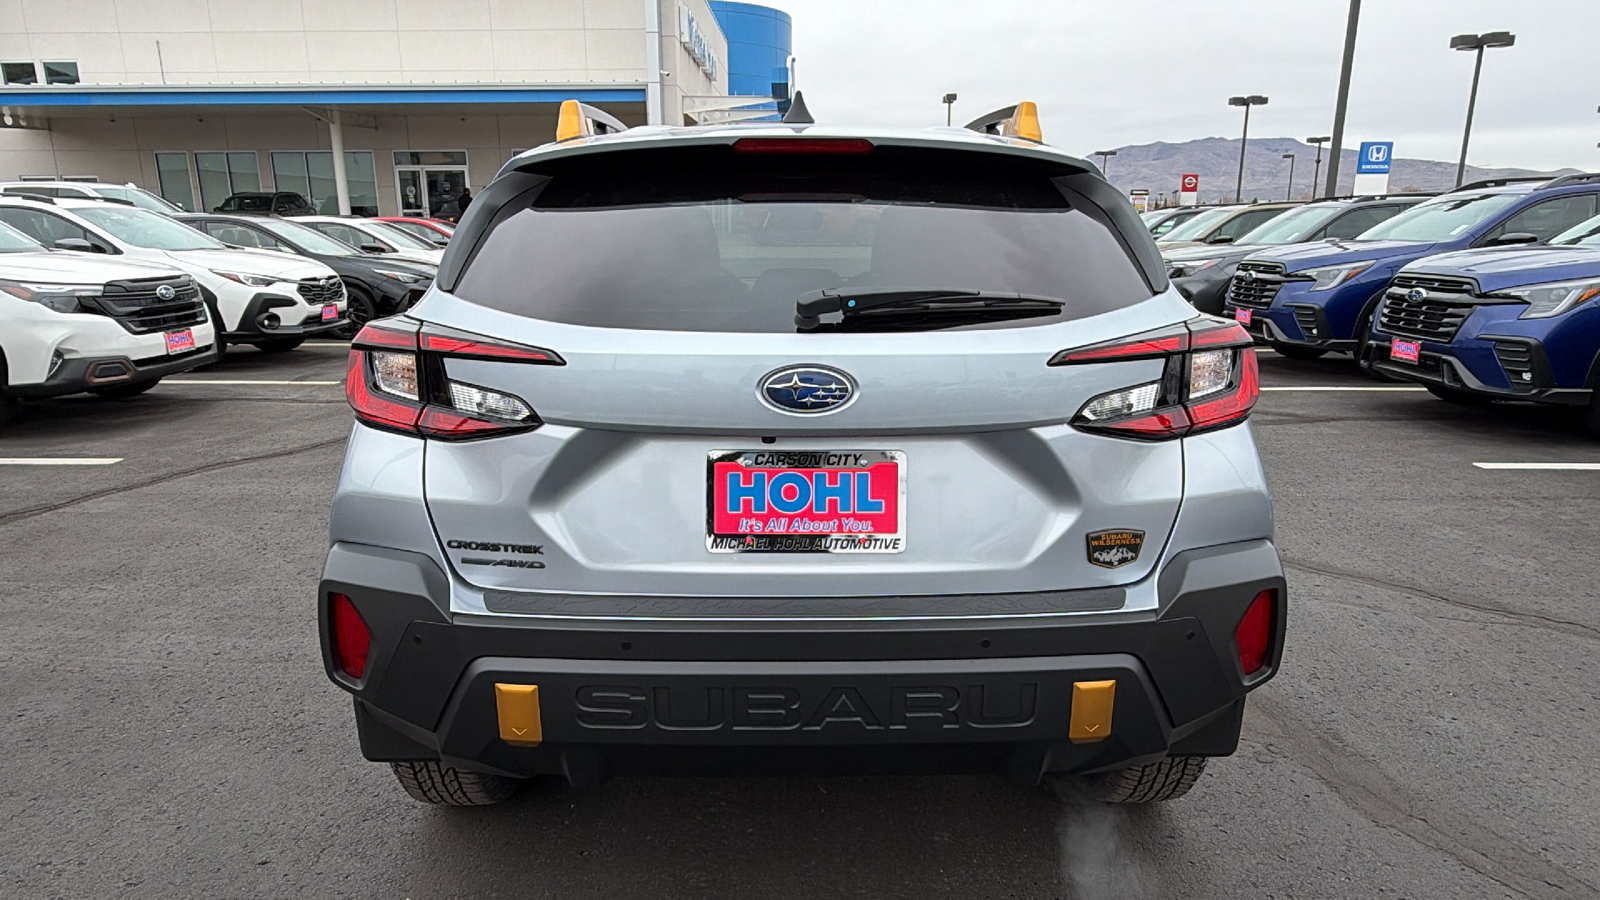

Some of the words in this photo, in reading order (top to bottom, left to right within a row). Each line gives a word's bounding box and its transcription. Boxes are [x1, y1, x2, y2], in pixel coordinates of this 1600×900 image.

[168, 333, 189, 344] HOHL
[1395, 342, 1415, 354] HOHL
[754, 453, 820, 467] CARSON
[826, 453, 863, 466] CITY
[727, 471, 885, 513] HOHL
[739, 518, 762, 531] It's
[766, 518, 786, 531] All
[790, 518, 838, 531] About
[842, 518, 873, 531] You.
[446, 539, 545, 555] CROSSTREK
[711, 537, 769, 550] MICHAEL
[775, 537, 810, 550] HOHL
[813, 537, 901, 550] AUTOMOTIVE
[1091, 538, 1141, 546] WILDERNESS
[491, 559, 546, 569] AWD
[574, 683, 1038, 731] SUBARU
